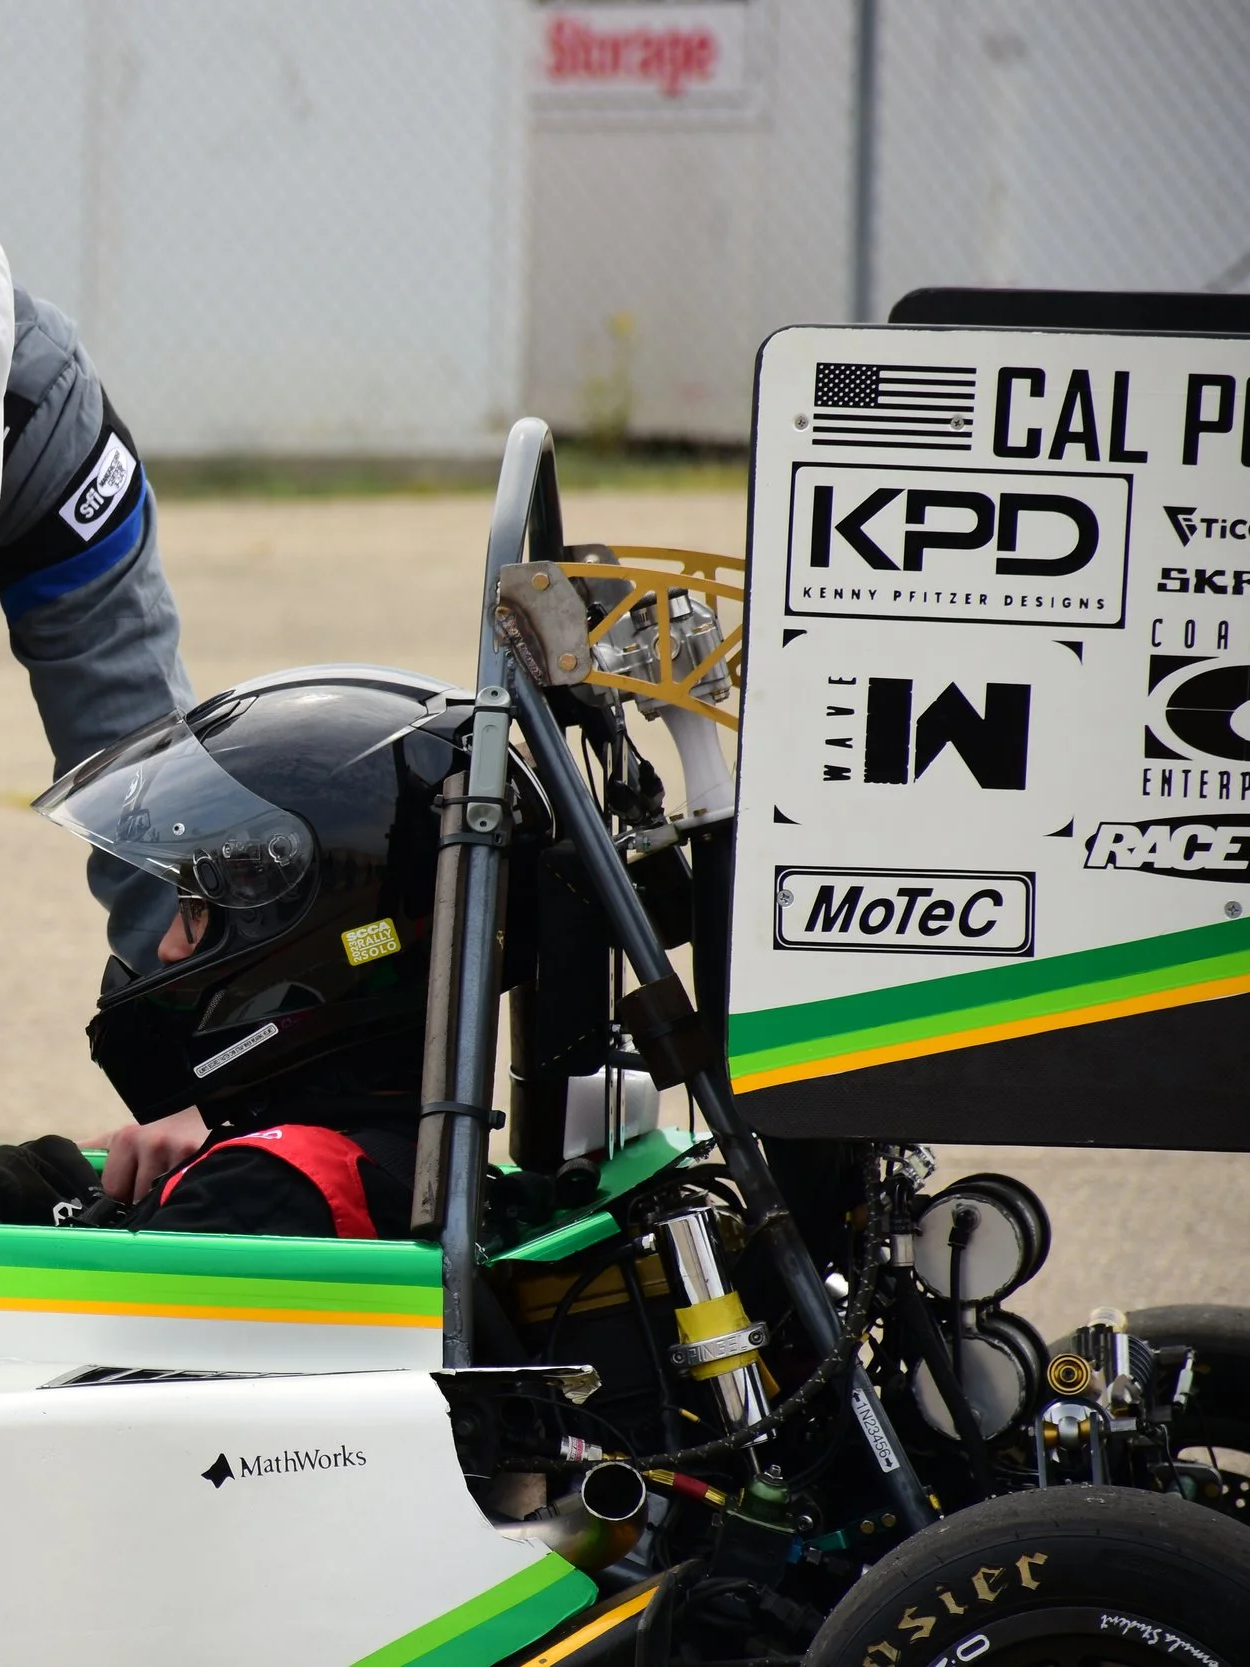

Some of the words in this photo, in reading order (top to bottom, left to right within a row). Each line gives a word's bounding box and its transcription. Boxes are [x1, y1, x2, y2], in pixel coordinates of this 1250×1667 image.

[549, 16, 717, 97] Storage
[993, 366, 1148, 463] CAL
[1182, 373, 1250, 468] P
[79, 487, 104, 519] sfi
[810, 485, 1100, 577] KPD
[1200, 517, 1250, 540] TiC
[802, 587, 877, 602] KENNY
[893, 590, 988, 606] PFITZER
[1004, 594, 1106, 610] DESIGNS
[1151, 618, 1229, 650] COA
[823, 676, 857, 782] WAVE
[1142, 768, 1250, 800] ENTERP
[1086, 823, 1249, 871] RACE
[804, 884, 1004, 938] MoTeC
[346, 921, 391, 941] SCCA
[357, 929, 391, 948] RALLY
[361, 941, 397, 960] SOLO
[240, 1445, 367, 1478] MathWorks
[1100, 1614, 1162, 1645] Student
[1164, 1633, 1220, 1667] ormula
